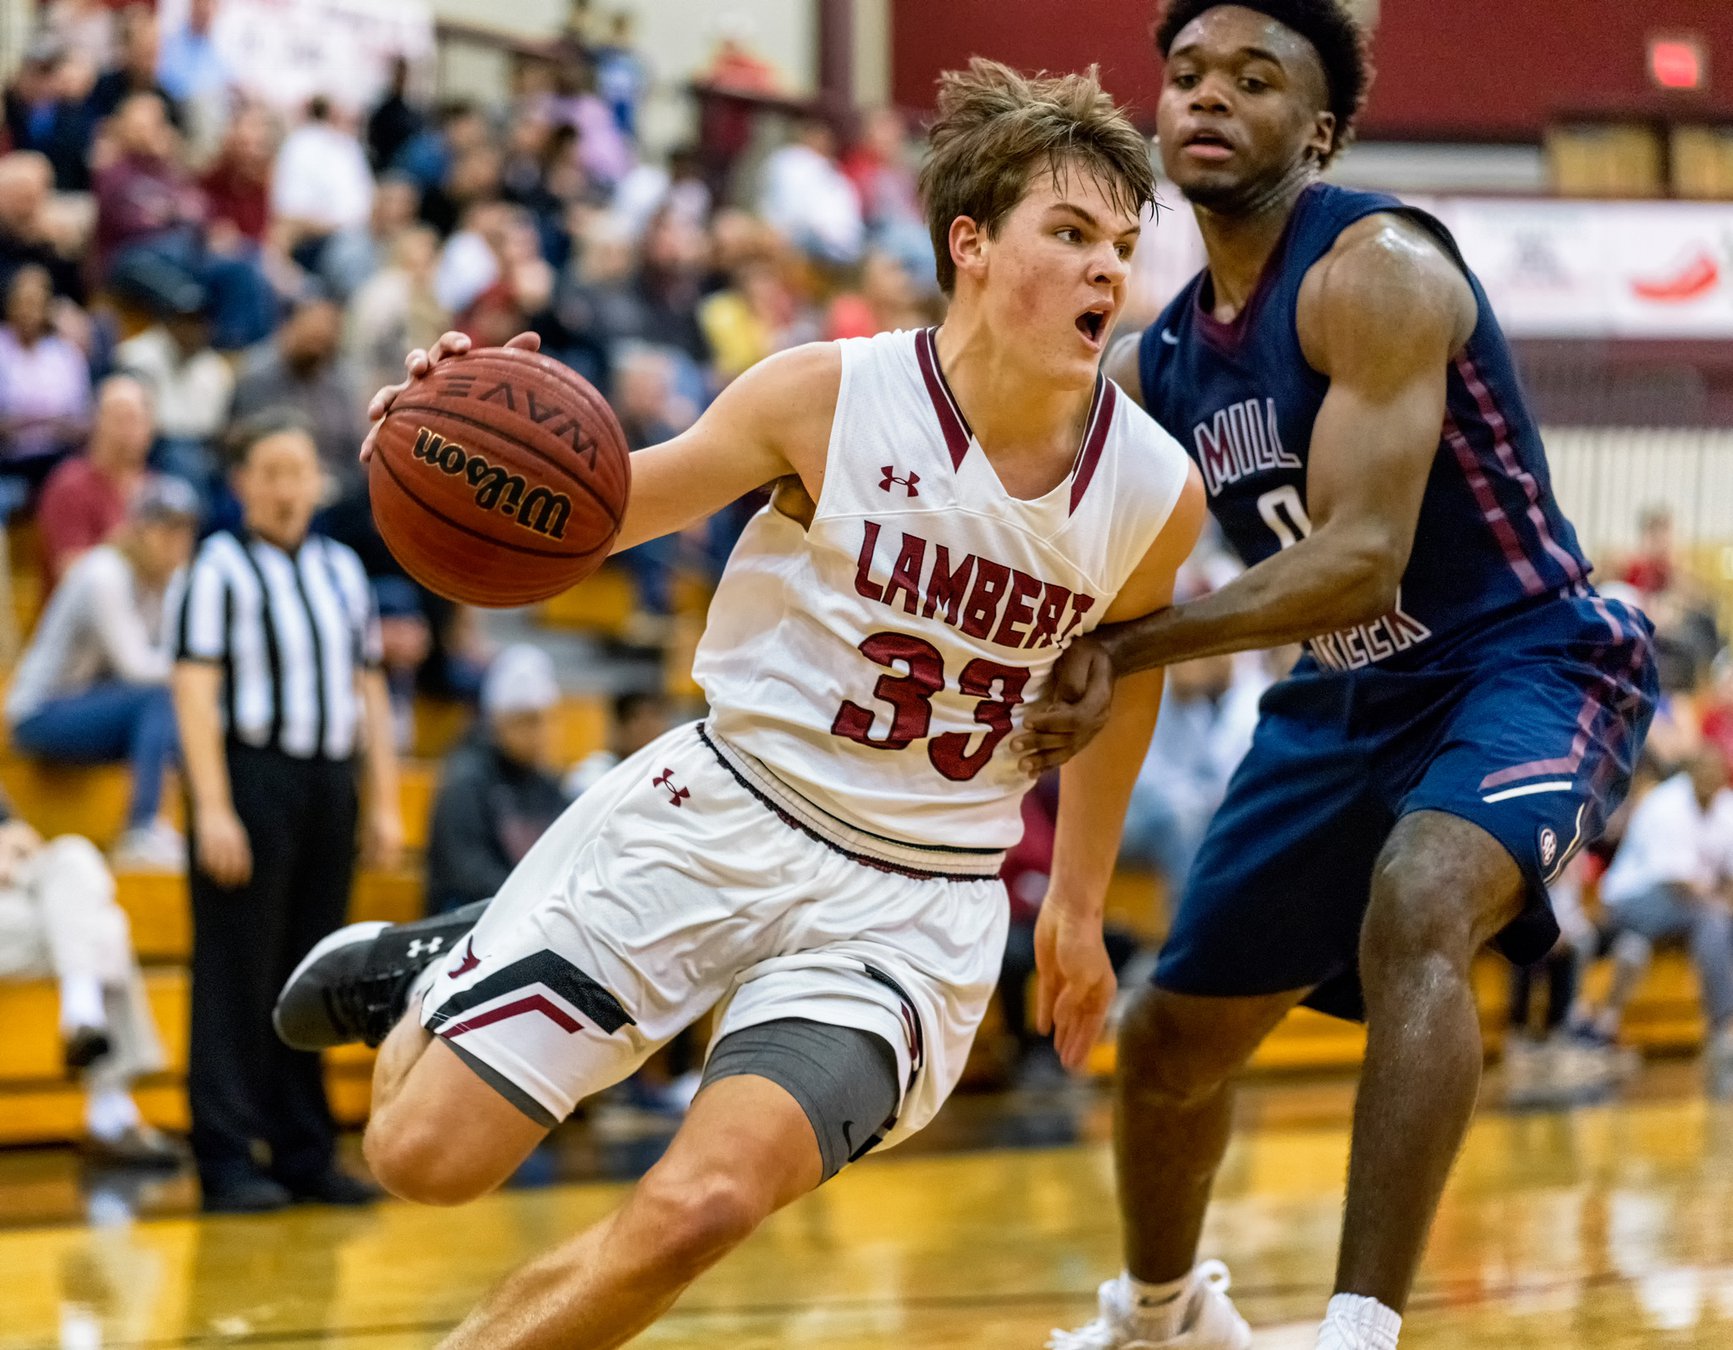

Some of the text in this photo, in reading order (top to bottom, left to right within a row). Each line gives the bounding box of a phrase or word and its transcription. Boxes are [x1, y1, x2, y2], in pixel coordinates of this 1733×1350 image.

[437, 375, 598, 472] WAVE
[1193, 397, 1302, 497] MILL
[412, 427, 573, 541] Wilson
[854, 519, 1095, 650] LAMBERT
[831, 631, 1031, 781] 33
